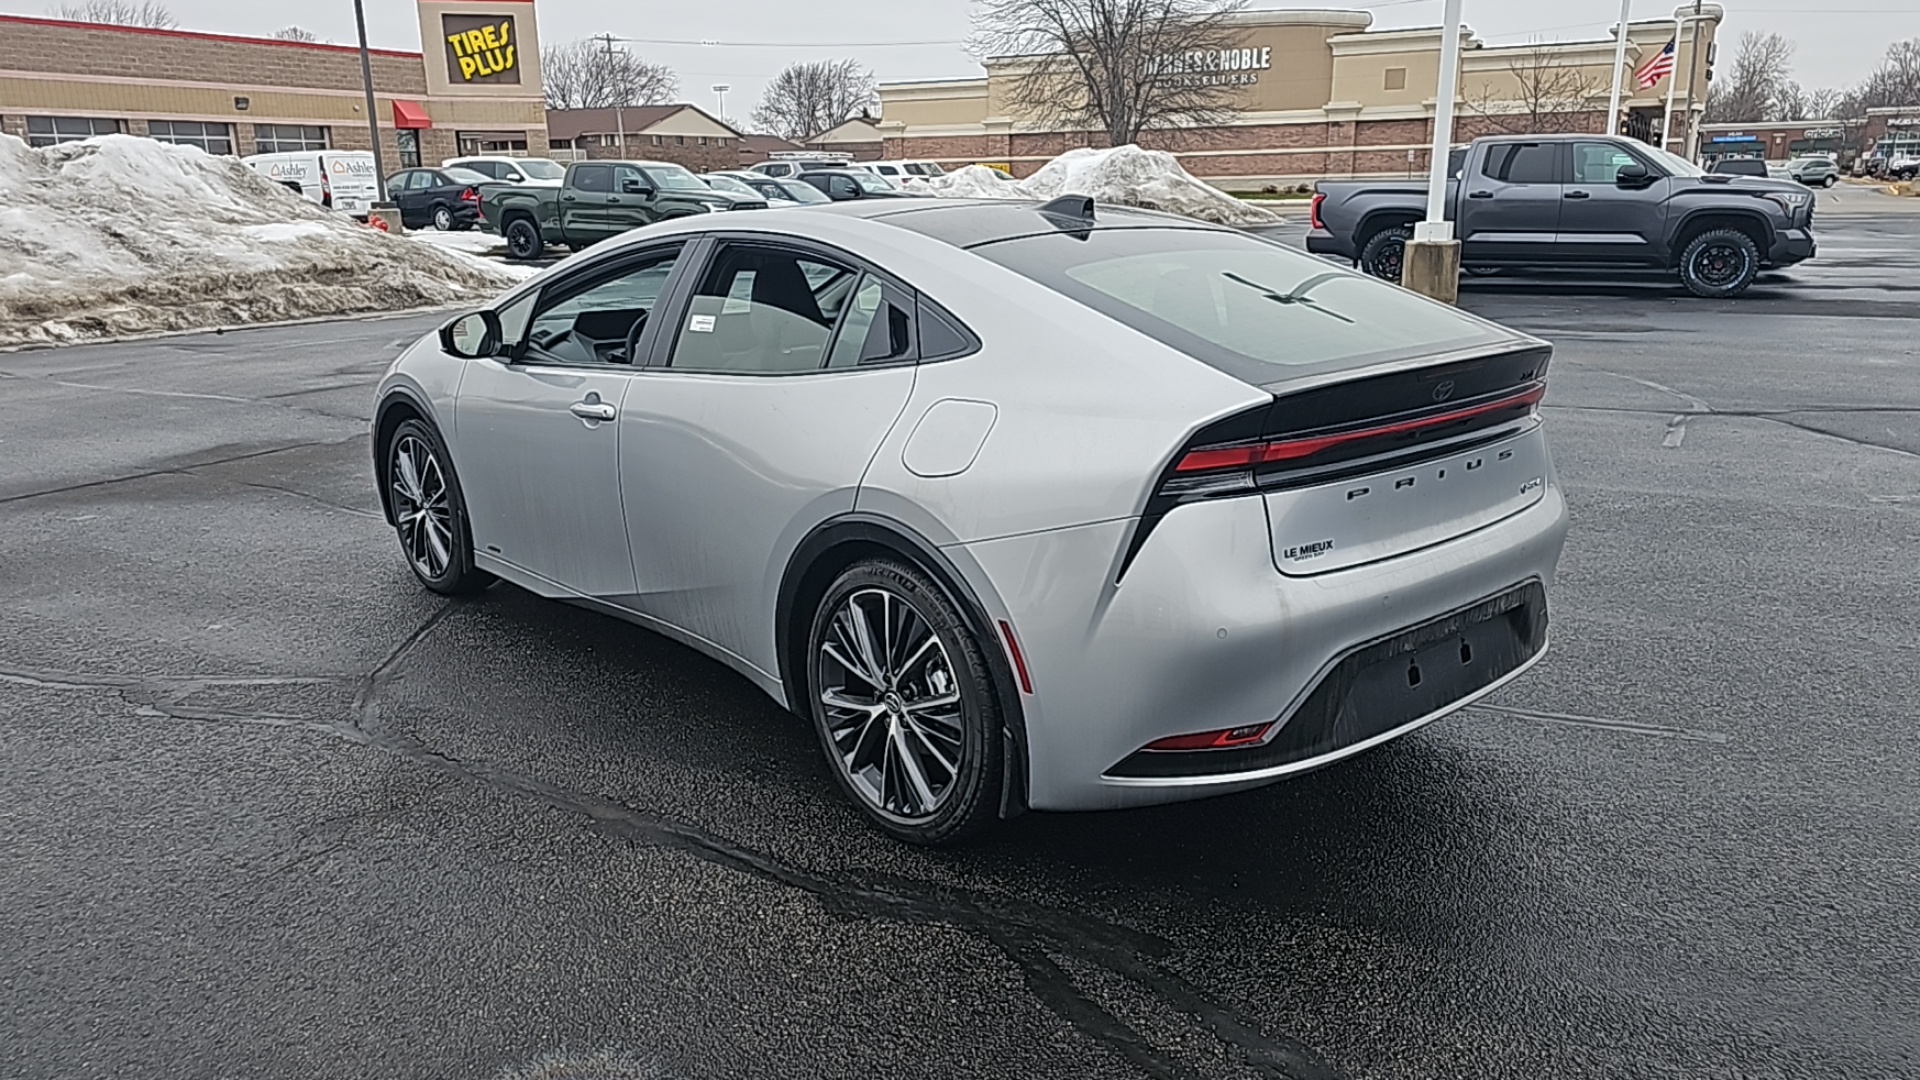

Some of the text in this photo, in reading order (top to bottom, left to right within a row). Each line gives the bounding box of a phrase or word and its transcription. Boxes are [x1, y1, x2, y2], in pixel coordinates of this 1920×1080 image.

[447, 21, 509, 57] TIRES
[458, 44, 515, 80] PLUS
[281, 163, 308, 179] Ashley
[1346, 449, 1513, 500] PRIUS
[1284, 539, 1333, 559] LE MIEUX
